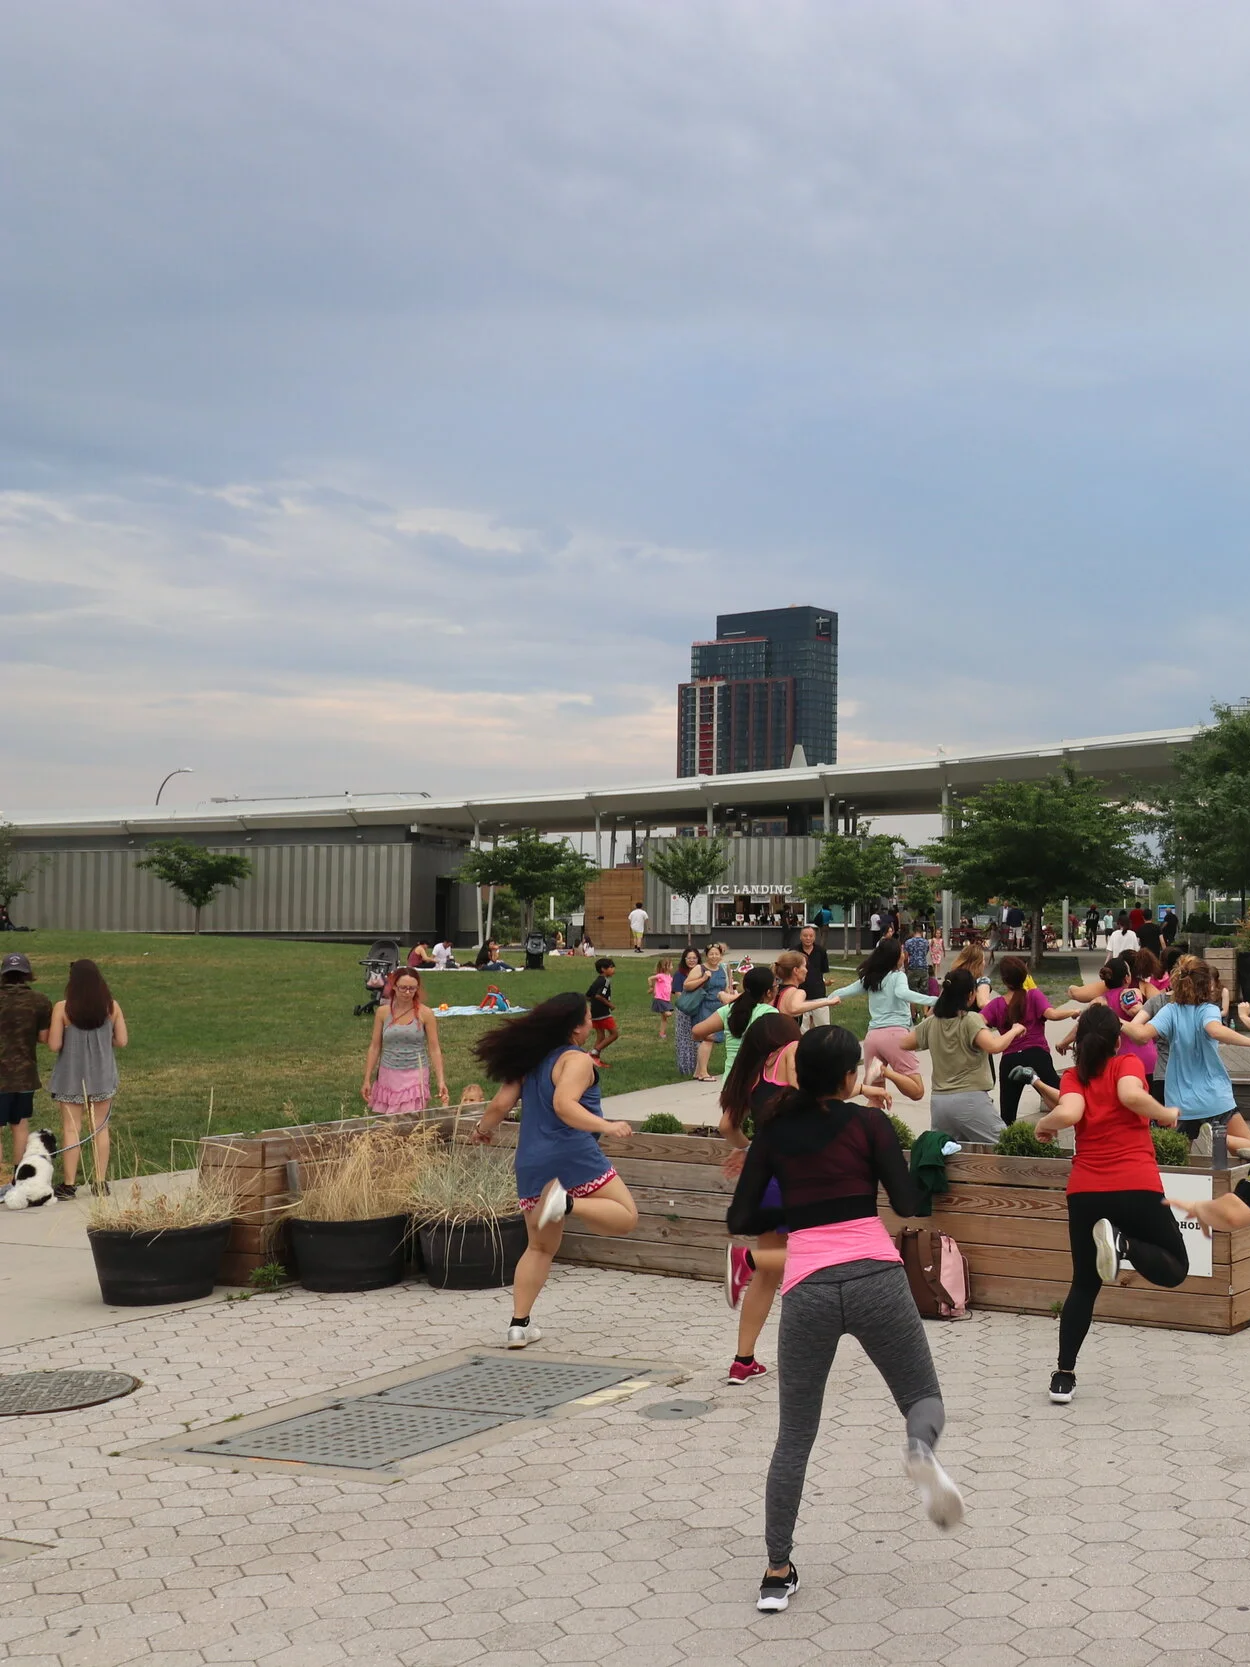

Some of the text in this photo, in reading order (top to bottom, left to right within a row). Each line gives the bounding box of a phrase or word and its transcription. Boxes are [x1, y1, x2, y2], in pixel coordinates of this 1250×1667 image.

[707, 885, 793, 895] LIC LANDING
[1178, 1221, 1201, 1230] HOL
